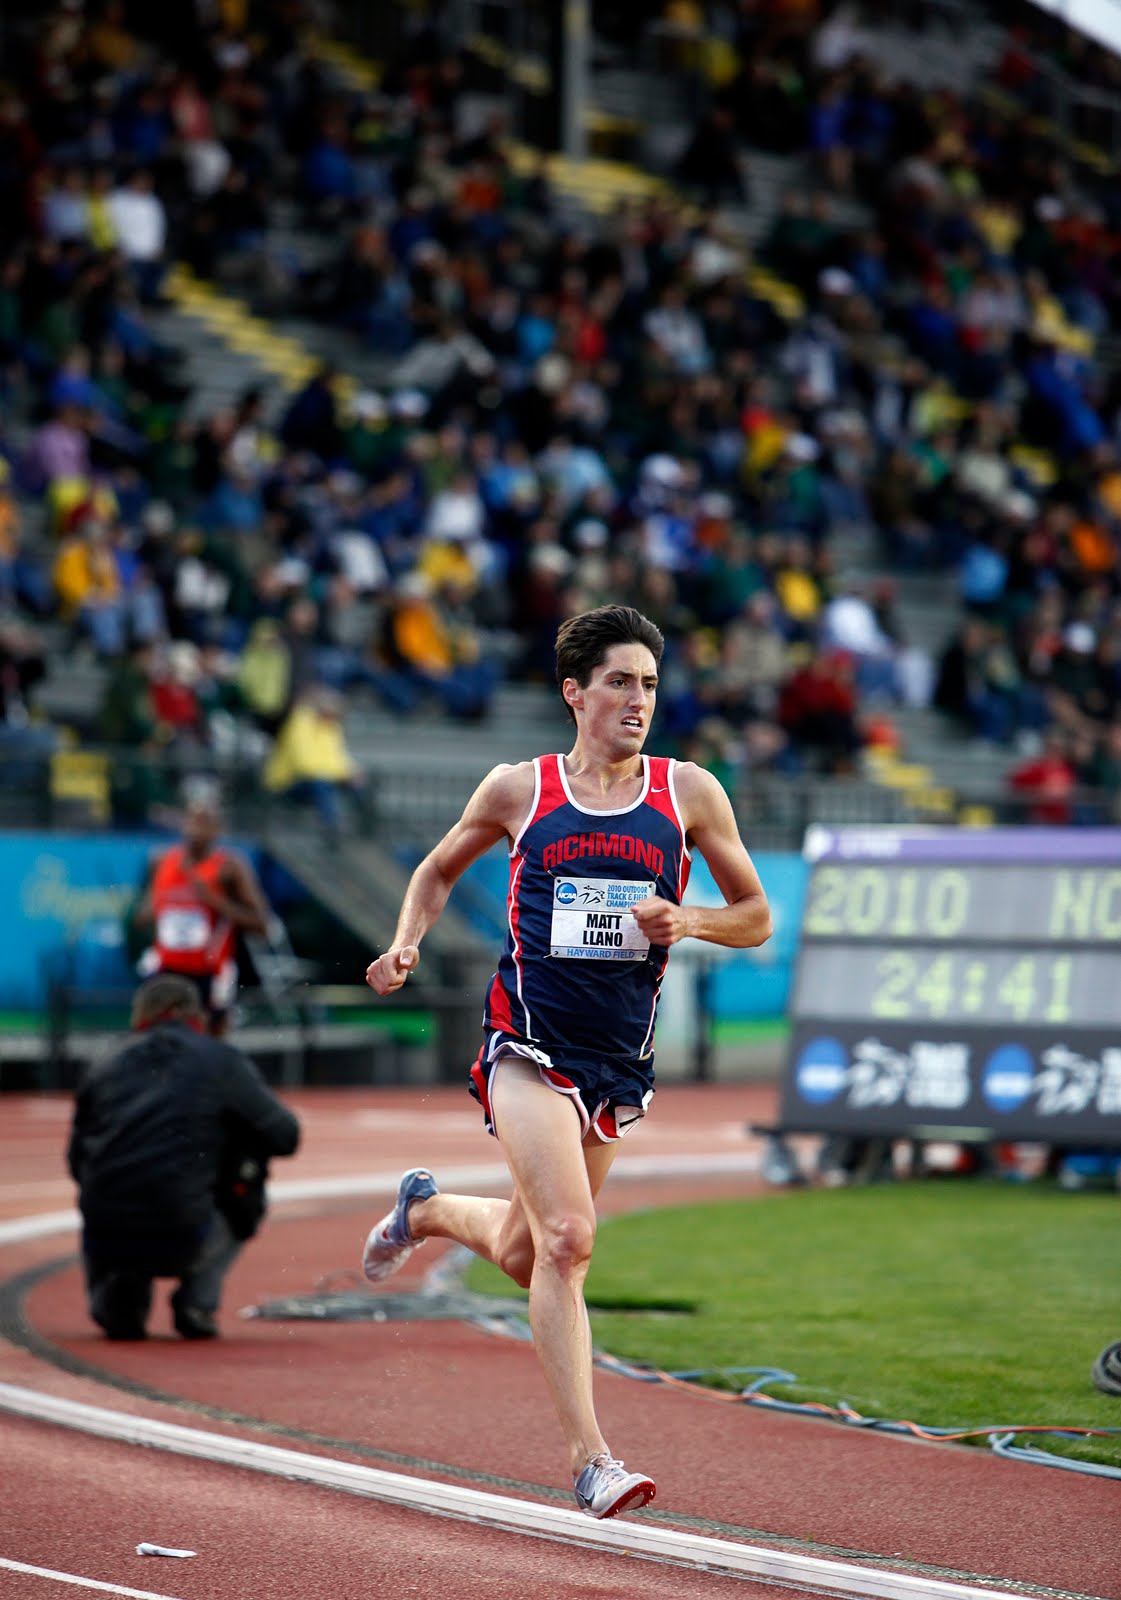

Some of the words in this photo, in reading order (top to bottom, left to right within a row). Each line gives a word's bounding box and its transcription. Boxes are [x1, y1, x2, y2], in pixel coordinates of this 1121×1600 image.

[543, 832, 664, 876] RICHMOND
[607, 884, 621, 892] 2010
[805, 867, 969, 937] 2010
[586, 913, 622, 929] MATT
[583, 930, 623, 947] LLANO
[567, 948, 612, 958] HAYWARD
[613, 950, 635, 959] FIELD
[871, 950, 1073, 1023] 24:41
